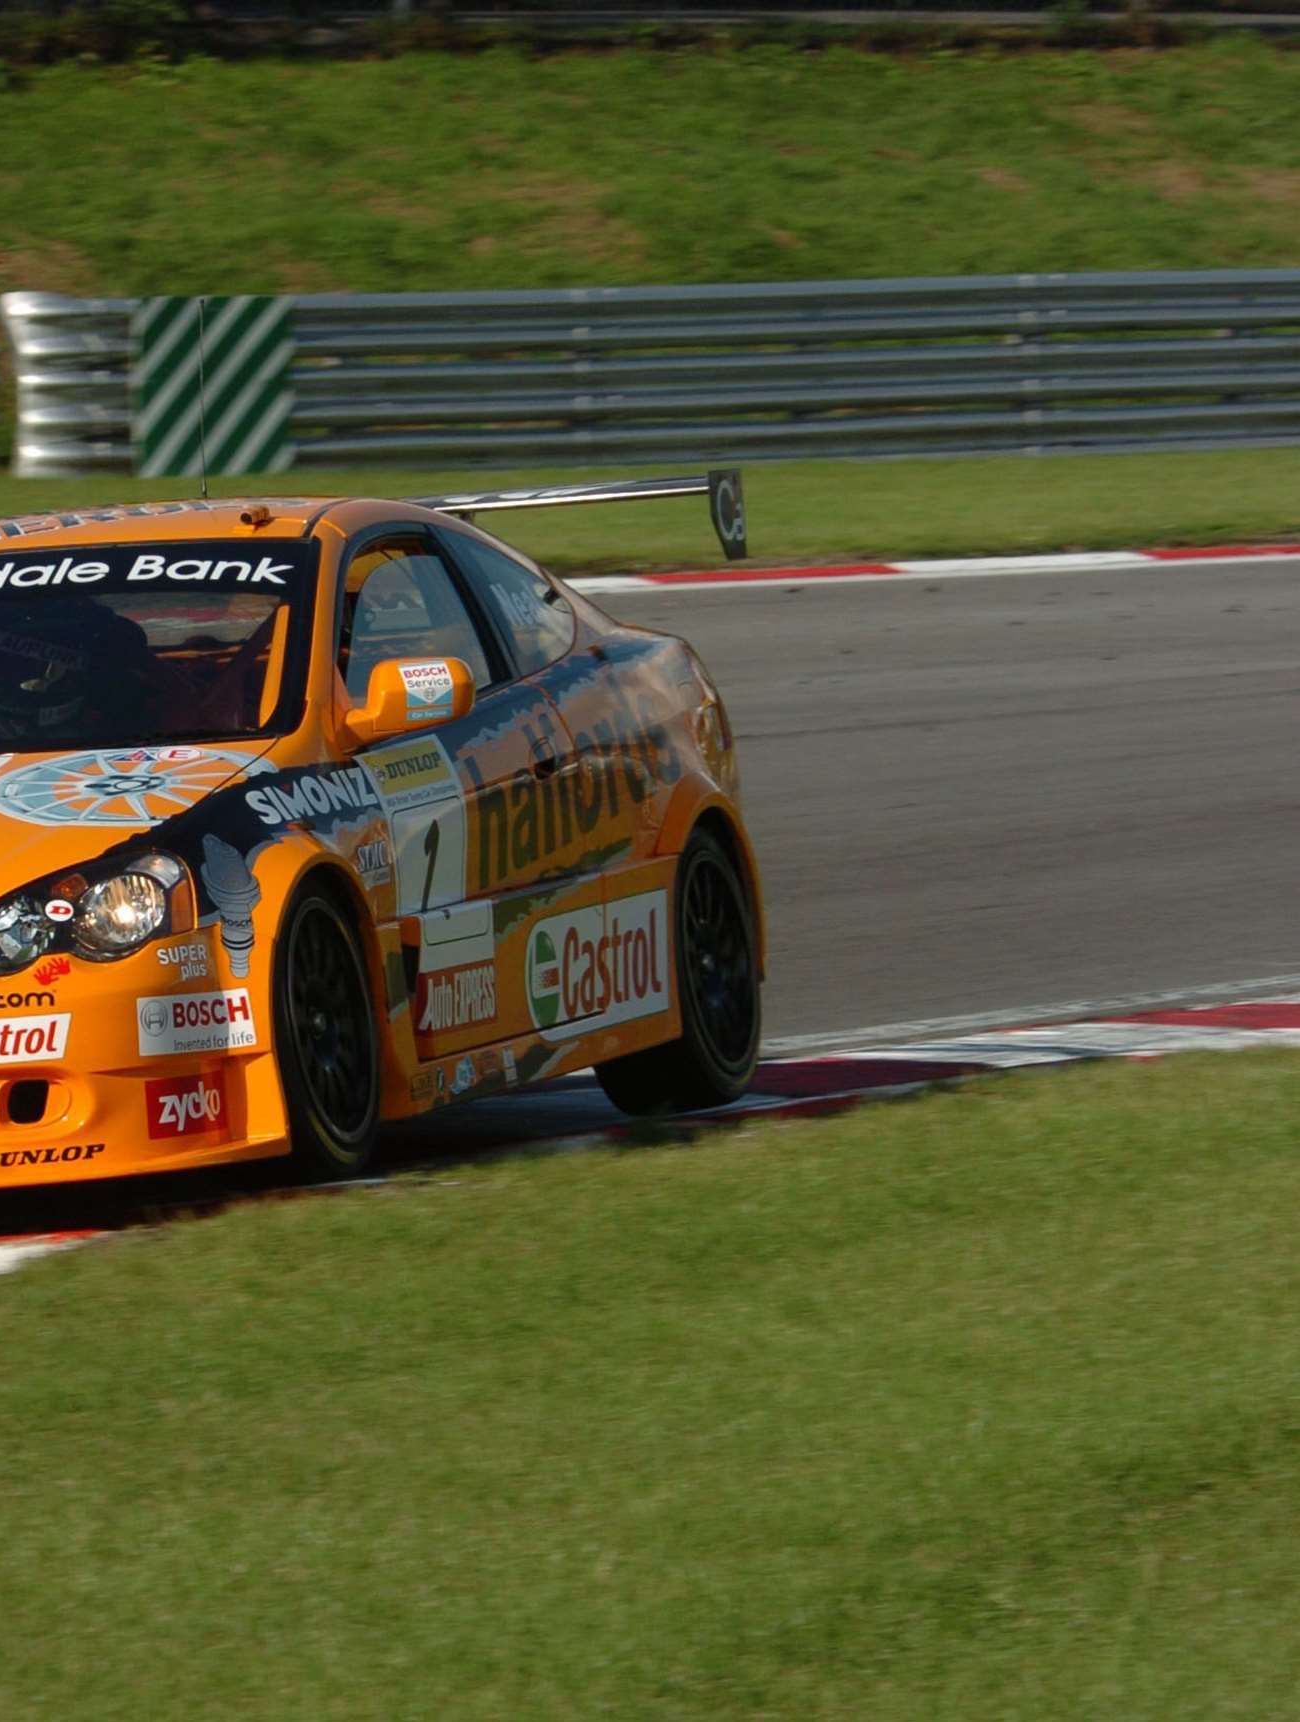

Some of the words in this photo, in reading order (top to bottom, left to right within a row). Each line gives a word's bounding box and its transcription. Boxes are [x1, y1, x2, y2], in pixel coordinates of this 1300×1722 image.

[126, 554, 295, 586] Bank
[403, 666, 448, 679] BOSCH
[406, 678, 451, 689] Service
[167, 749, 190, 759] E
[385, 750, 441, 780] DUNLOP
[245, 768, 378, 826] SIMONIZ
[421, 818, 440, 912] 1
[156, 944, 208, 965] SUPER
[562, 907, 662, 1019] Castrol
[180, 962, 208, 982] plus
[172, 995, 250, 1029] BOSCH
[419, 975, 452, 1031] Auto
[454, 962, 496, 1025] EXPRESS
[174, 1039, 211, 1052] Invented
[212, 1034, 229, 1049] for
[232, 1031, 254, 1046] life
[158, 1082, 222, 1132] zycko
